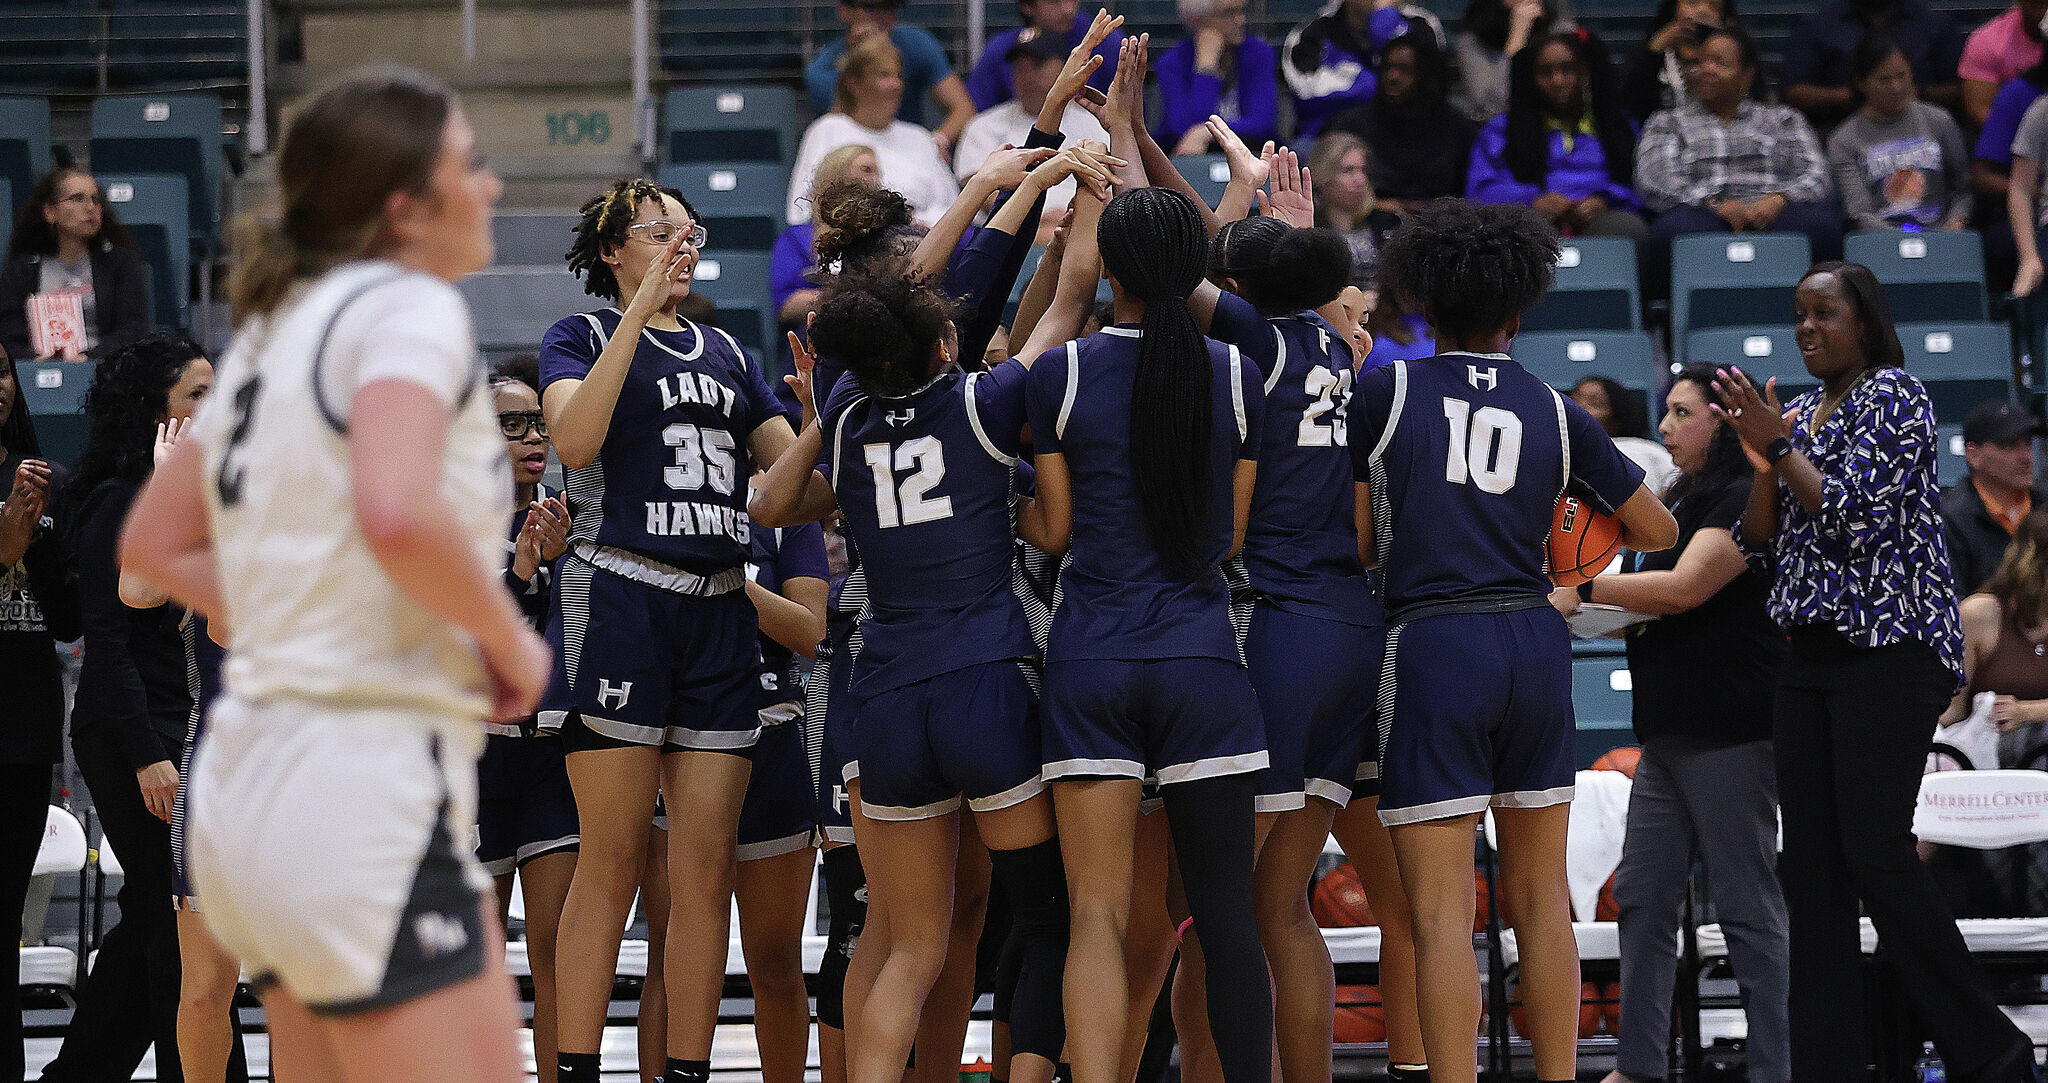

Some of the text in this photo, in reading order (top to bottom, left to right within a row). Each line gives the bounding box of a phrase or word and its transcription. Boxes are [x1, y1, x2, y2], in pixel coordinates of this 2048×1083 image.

[545, 109, 612, 145] 106
[656, 371, 736, 418] LADY
[1466, 364, 1498, 392] H
[1297, 364, 1354, 447] 23
[662, 422, 736, 496] 35
[1443, 396, 1523, 495] 10
[863, 434, 954, 529] 12
[644, 501, 751, 545] HAWKS
[597, 677, 633, 710] H
